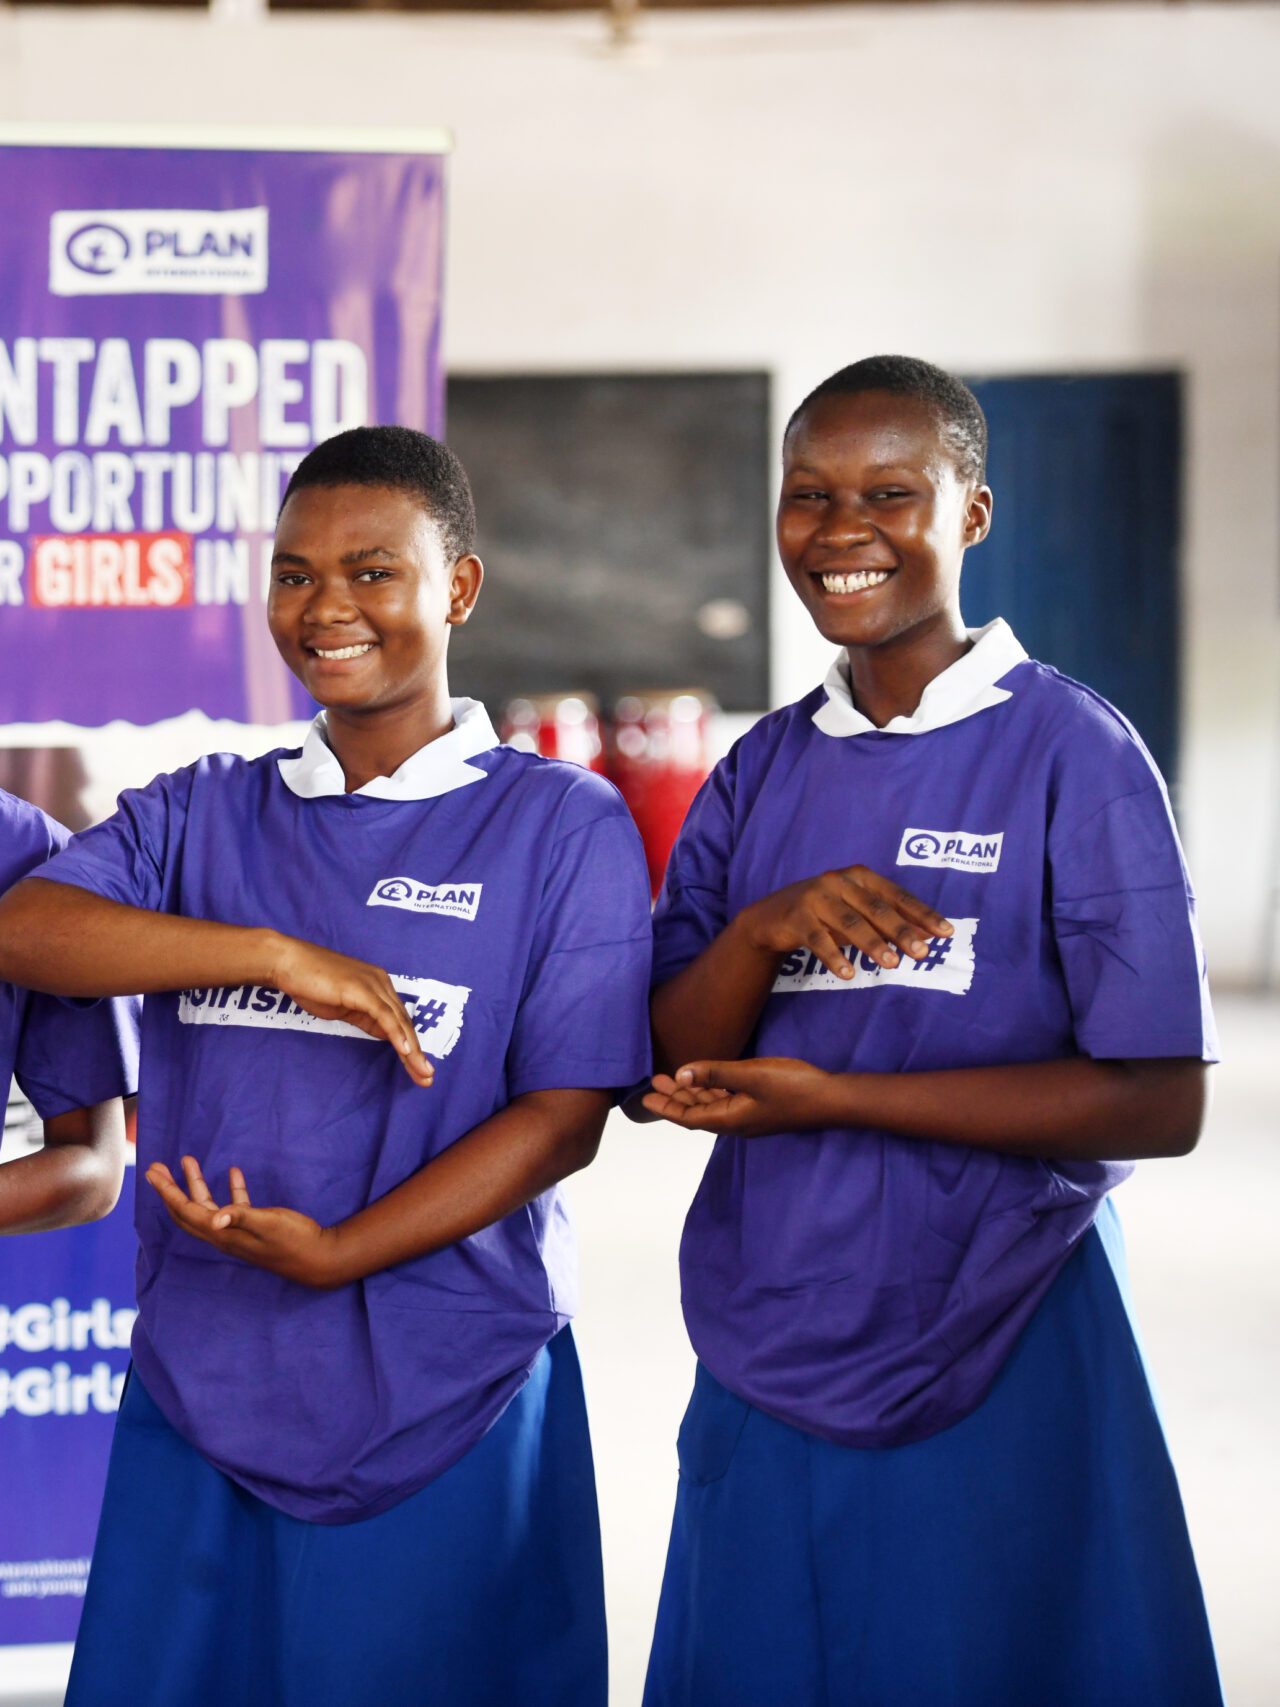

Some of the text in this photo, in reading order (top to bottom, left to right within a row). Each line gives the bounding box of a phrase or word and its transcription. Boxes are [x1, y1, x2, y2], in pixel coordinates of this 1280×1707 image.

[145, 229, 253, 257] PLAN
[34, 538, 184, 606] GIRLS
[195, 540, 250, 606] IN
[943, 839, 998, 858] PLAN
[416, 889, 476, 906] PLAN
[413, 902, 471, 915] INTERNATIONAL
